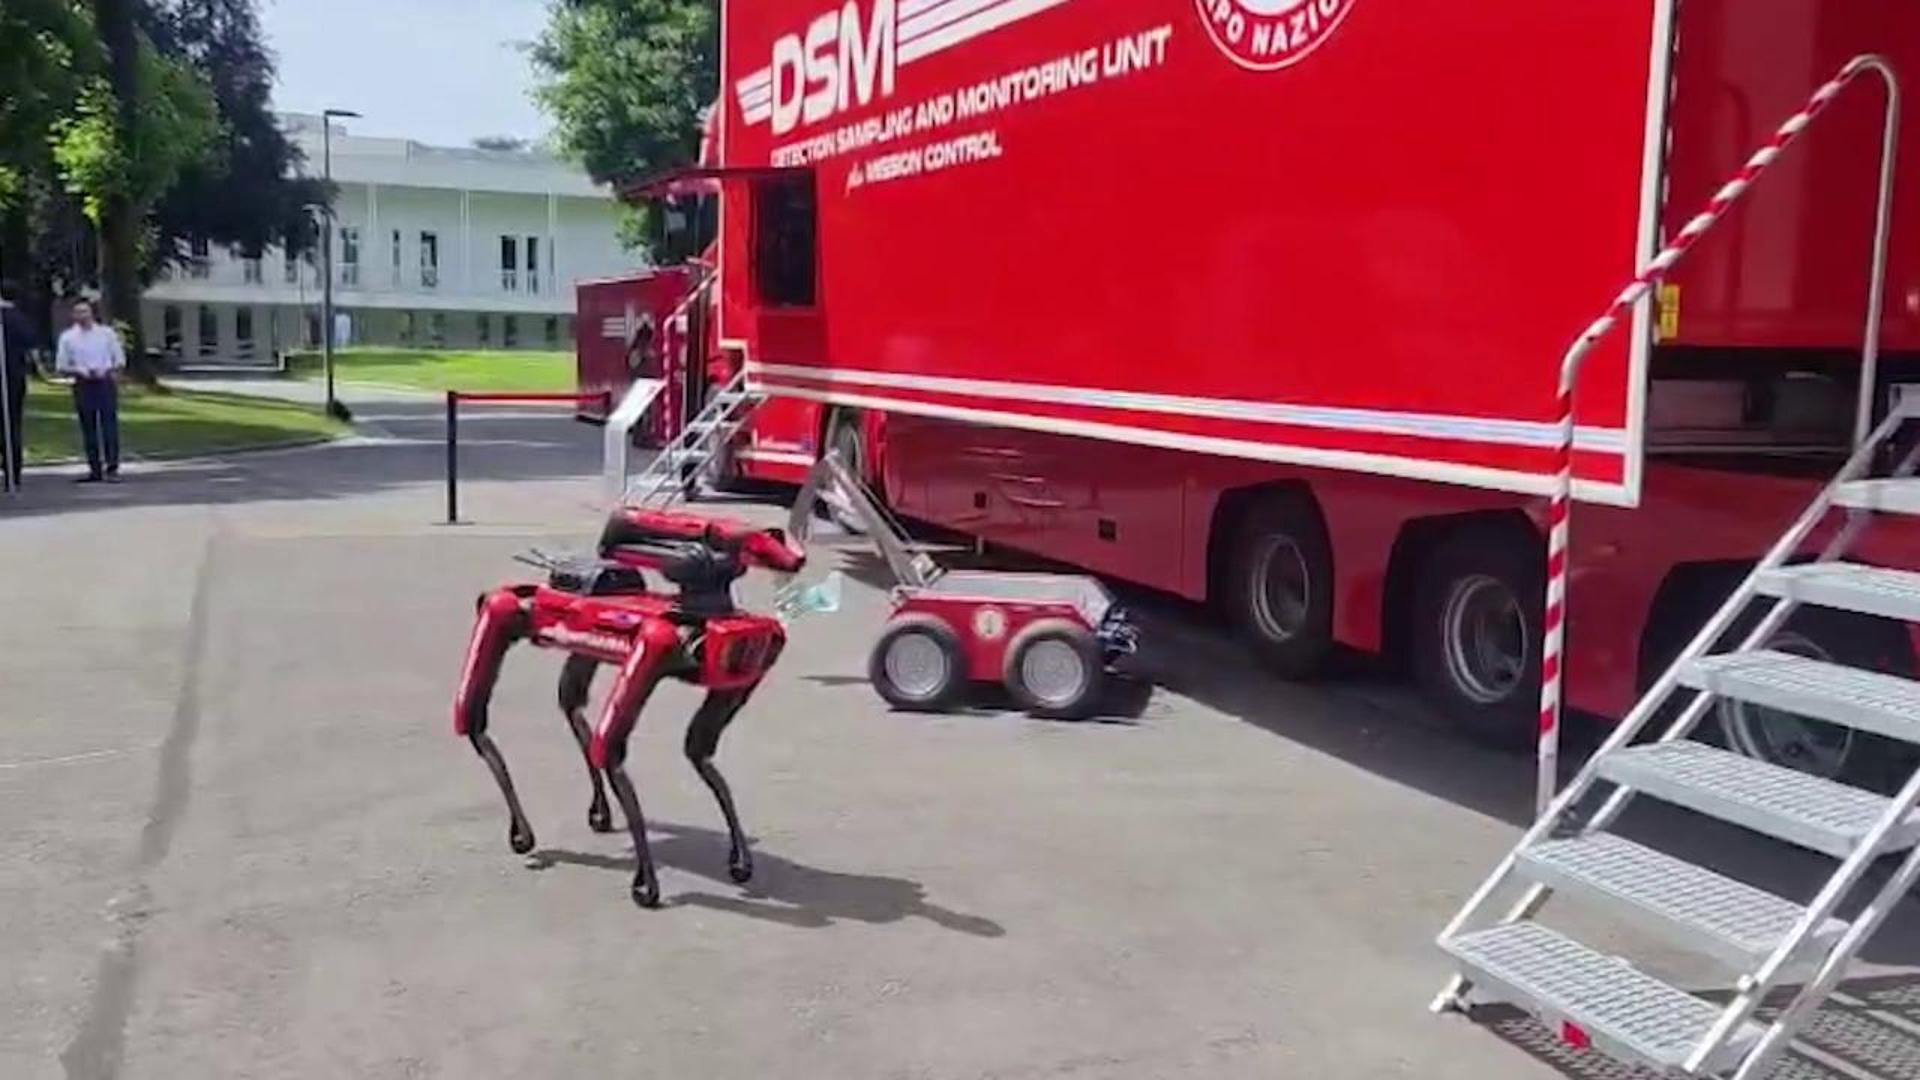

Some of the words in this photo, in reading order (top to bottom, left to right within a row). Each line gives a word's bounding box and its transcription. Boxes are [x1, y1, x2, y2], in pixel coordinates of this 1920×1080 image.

[771, 0, 895, 136] DSM
[836, 106, 912, 154] SAMPLING
[915, 95, 953, 130] AND
[956, 48, 1098, 121] MONITORING
[1103, 24, 1172, 77] UNIT
[924, 130, 1002, 171] CONTROL
